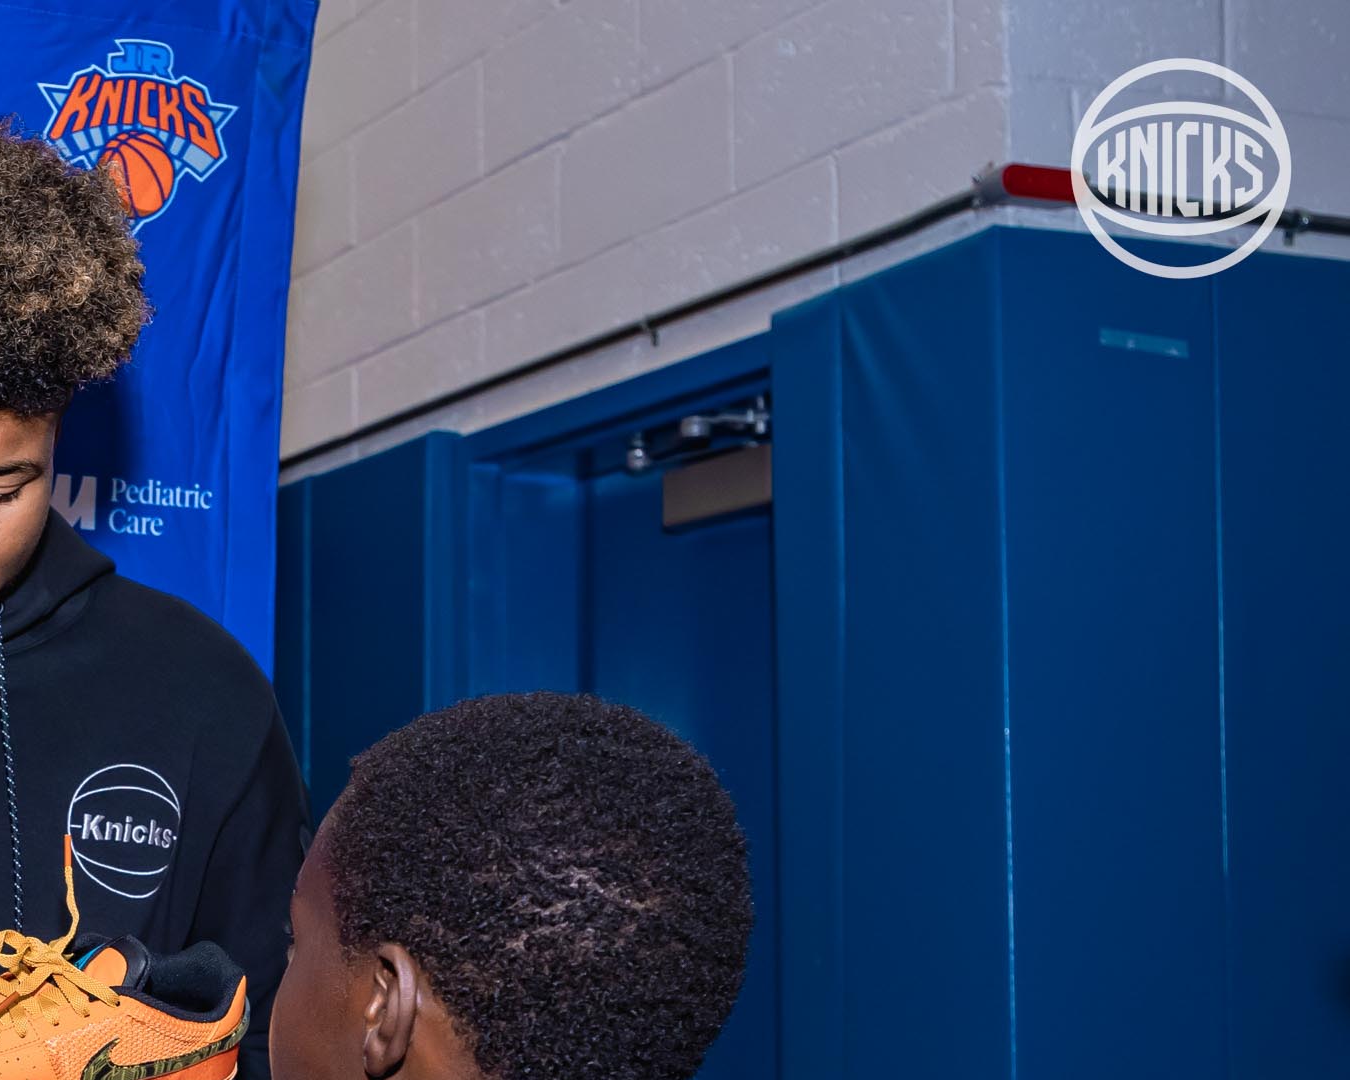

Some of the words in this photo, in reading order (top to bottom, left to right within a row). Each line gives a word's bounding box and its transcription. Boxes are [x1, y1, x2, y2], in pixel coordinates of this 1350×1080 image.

[112, 44, 168, 76] JR
[50, 74, 220, 158] KNICKS
[50, 474, 97, 531] M
[111, 478, 213, 510] Pediatric
[108, 508, 164, 537] Care
[81, 813, 173, 849] Knicks
